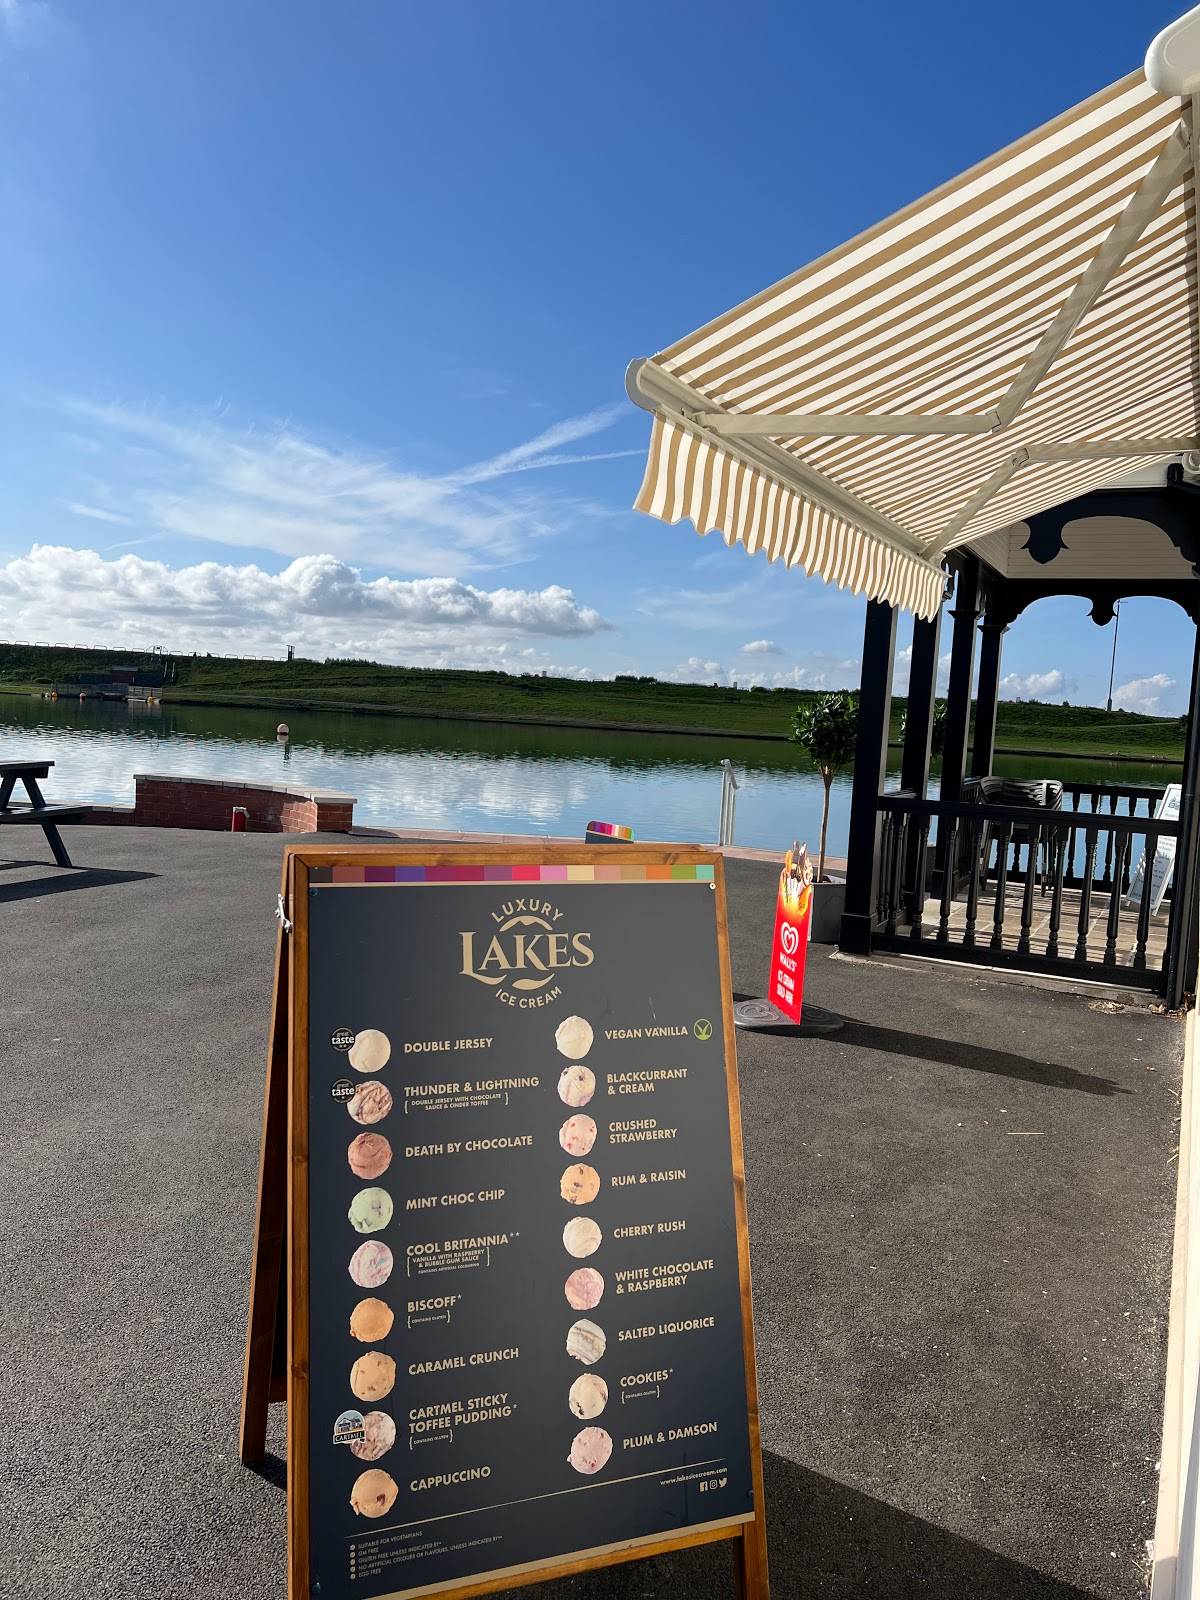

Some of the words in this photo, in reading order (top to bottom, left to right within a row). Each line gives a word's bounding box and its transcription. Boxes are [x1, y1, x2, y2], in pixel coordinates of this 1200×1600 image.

[492, 899, 564, 922] LUXURY
[458, 932, 594, 985] LAKES
[496, 989, 516, 1006] ICE
[519, 986, 562, 1008] CREAM
[332, 1036, 354, 1044] taste
[605, 1029, 641, 1040] VEGAN
[645, 1027, 688, 1037] VANILLA
[404, 1040, 450, 1053] DOUBLE
[454, 1038, 493, 1050] JERSEY
[607, 1069, 687, 1083] BLACKCURRANT
[332, 1088, 354, 1096] taste
[404, 1083, 460, 1096] THUNDER
[464, 1082, 472, 1092] &
[476, 1077, 539, 1091] LIGHTNING
[608, 1086, 616, 1095] &
[619, 1083, 654, 1094] CREAM
[609, 1119, 656, 1131] CRUSHED
[610, 1129, 677, 1144] STRAWBERRY
[406, 1145, 443, 1157] DEATH
[448, 1142, 461, 1153] BY
[466, 1136, 533, 1151] CHOCOLATE
[611, 1175, 636, 1186] RUM
[640, 1174, 647, 1184] &
[650, 1170, 686, 1182] RAISIN
[406, 1197, 437, 1210] MINT
[441, 1193, 474, 1206] CHOC
[478, 1189, 505, 1201] CHIP
[614, 1224, 654, 1238] CHERRY
[658, 1220, 686, 1232] RUSH
[407, 1243, 440, 1256] COOL
[454, 1249, 484, 1257] RASPBERRY
[615, 1268, 648, 1282] WHITE
[652, 1260, 714, 1276] CHOCOLATE
[616, 1284, 624, 1294] &
[628, 1275, 688, 1293] RASPBERRY
[618, 1326, 655, 1341] SALTED
[659, 1317, 715, 1335] LIQUORICE
[409, 1357, 465, 1375] CARAMEL
[469, 1348, 519, 1365] CRUNCH
[409, 1401, 464, 1420] CARTMEL
[468, 1393, 508, 1410] STICKY
[409, 1416, 451, 1433] TOFFEE
[623, 1434, 653, 1449] PLUM
[656, 1432, 665, 1443] &
[669, 1422, 718, 1441] DAMSON
[410, 1466, 491, 1492] CAPPUCCINO
